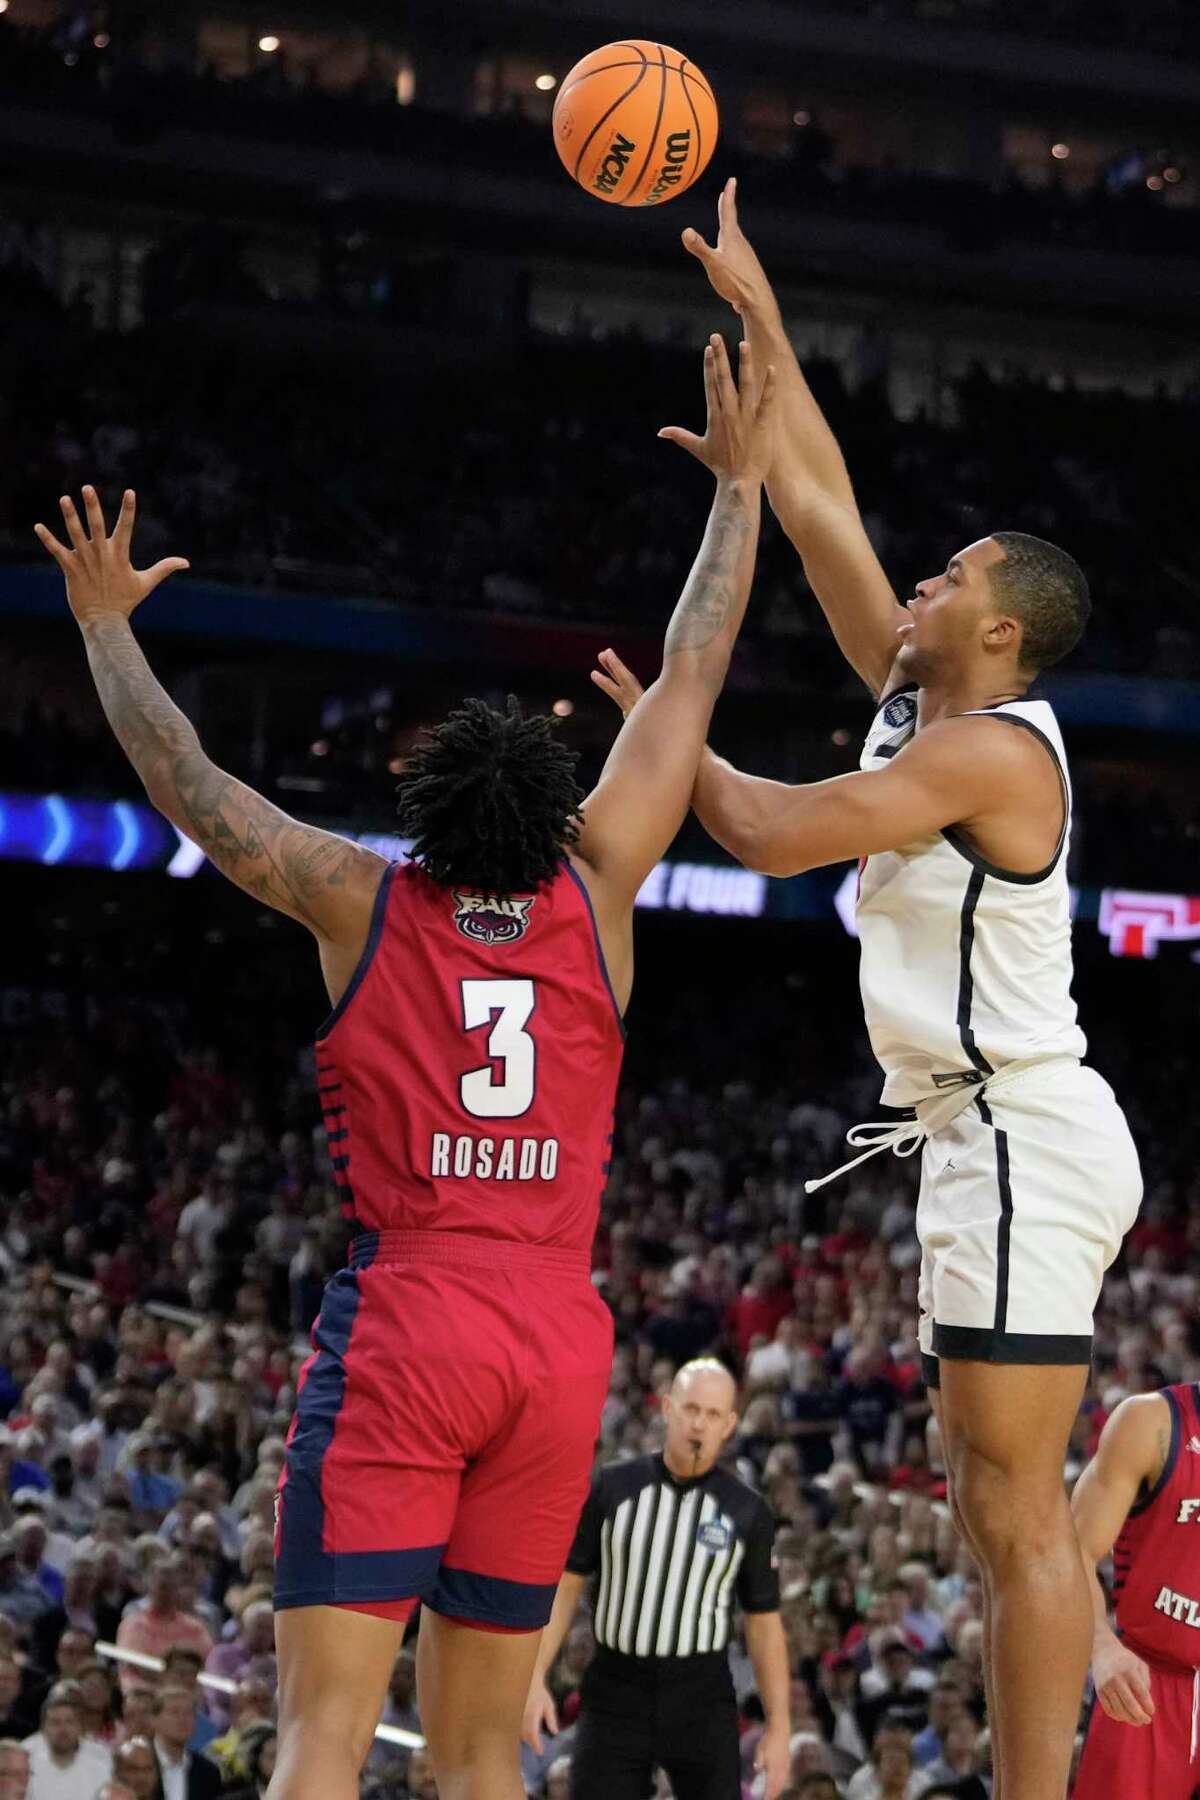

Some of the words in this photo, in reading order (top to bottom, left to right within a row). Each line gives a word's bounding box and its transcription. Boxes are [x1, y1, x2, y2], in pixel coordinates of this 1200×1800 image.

[592, 132, 636, 194] NCAA
[456, 894, 531, 920] FAU
[460, 979, 535, 1118] 3
[431, 1133, 559, 1181] ROSADO
